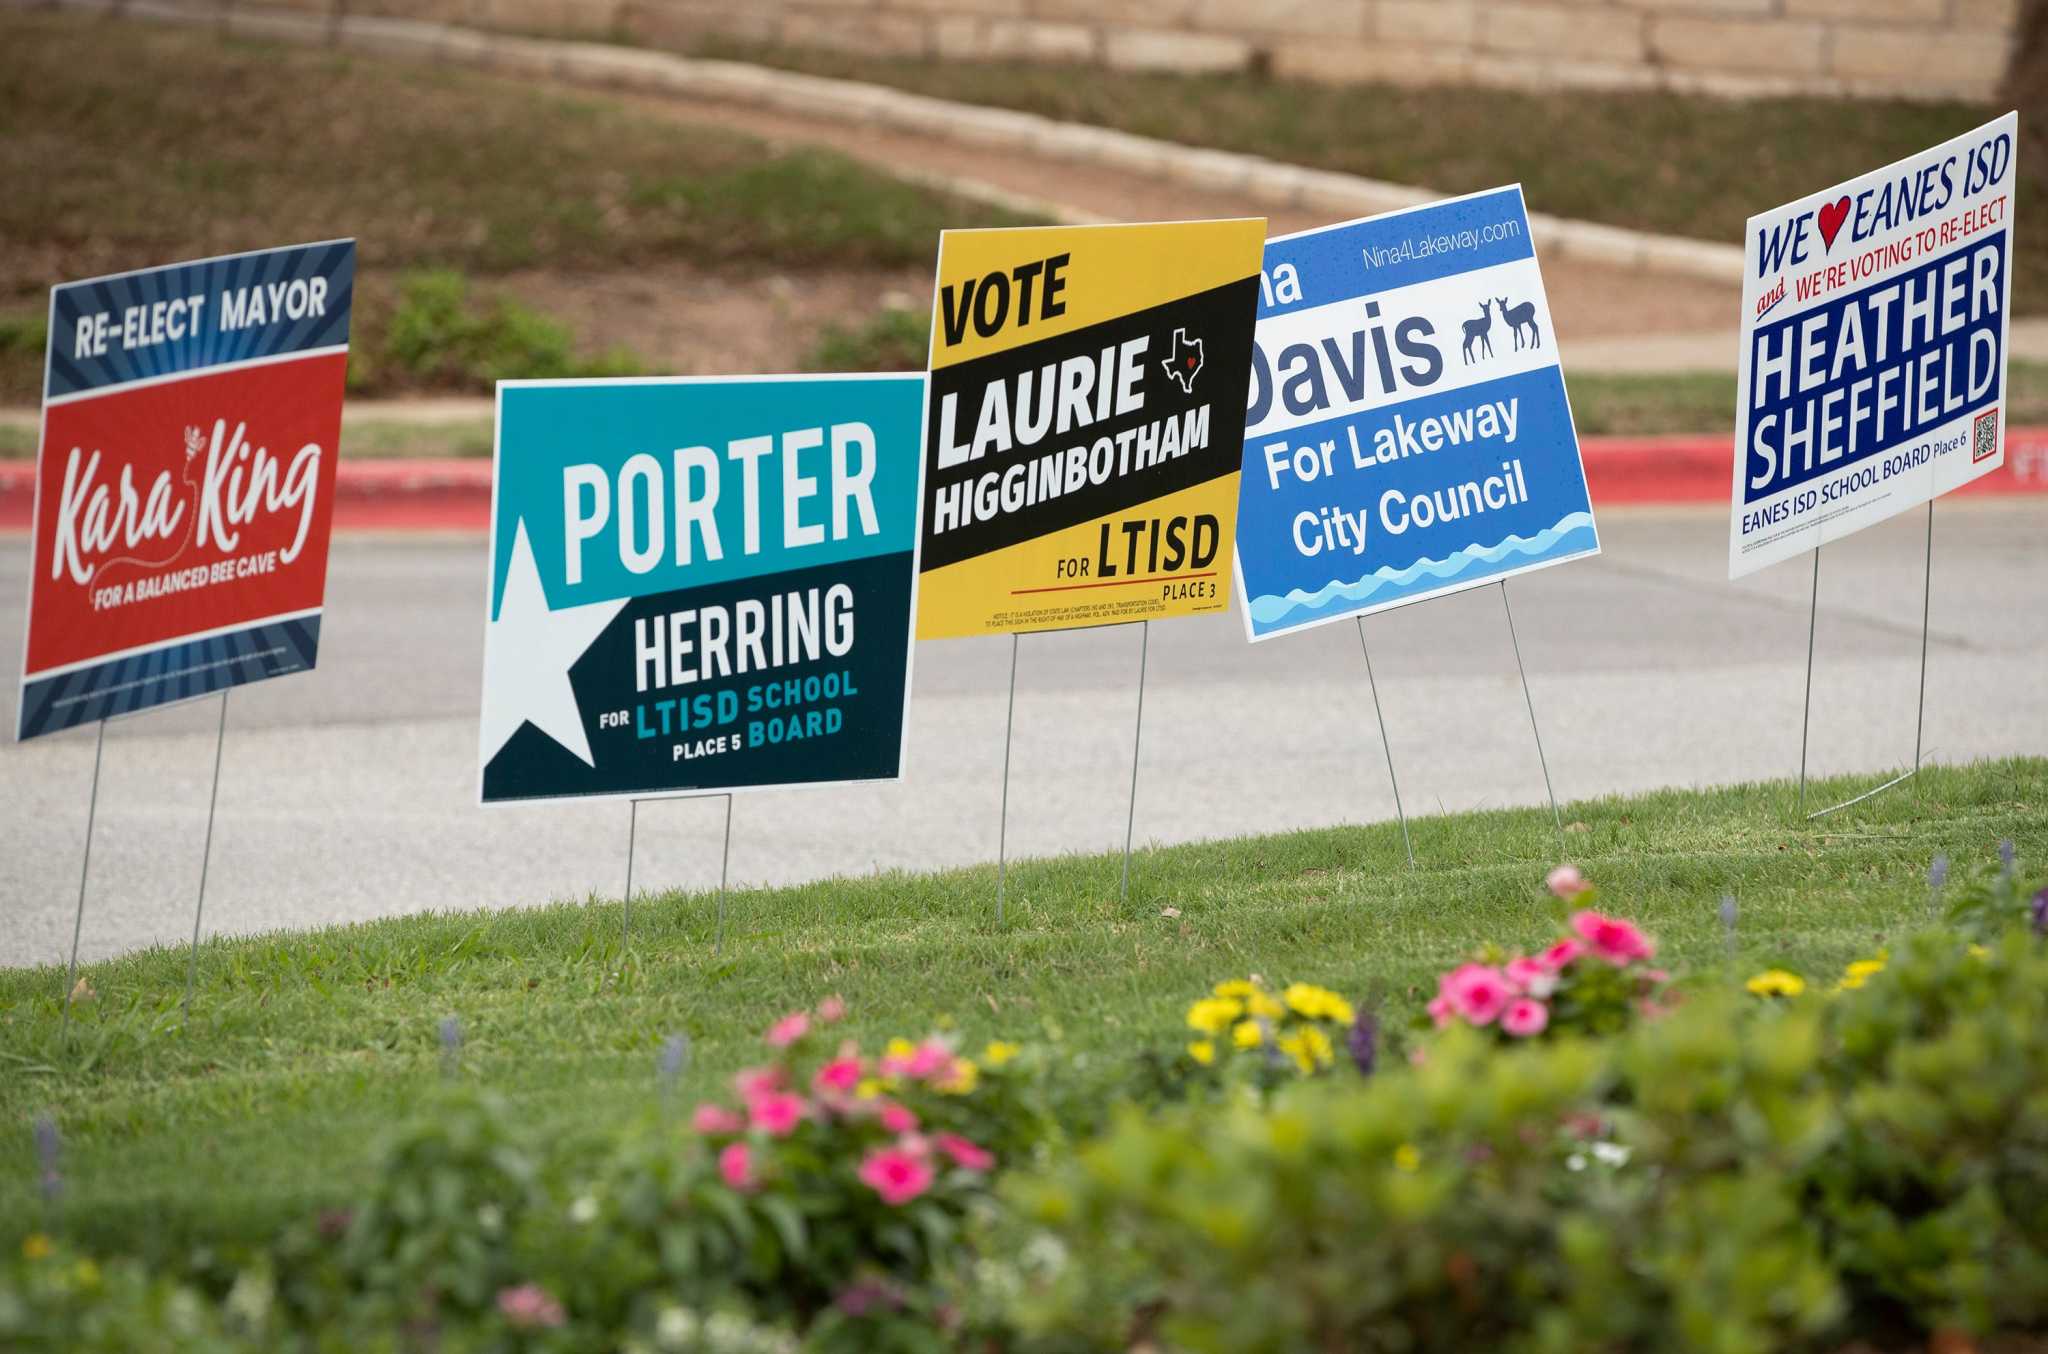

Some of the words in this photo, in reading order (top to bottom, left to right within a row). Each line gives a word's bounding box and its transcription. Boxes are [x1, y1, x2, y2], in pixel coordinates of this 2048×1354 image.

[1363, 217, 1520, 271] Nina4Lakeway.com
[1757, 277, 1786, 315] and
[1796, 262, 1847, 303] WE'RE
[1850, 237, 1912, 281] VOTING
[1916, 228, 1936, 256] TO
[1940, 195, 2007, 247] RE-ELECT
[1759, 211, 1814, 279] WE
[1852, 156, 1957, 242] EANES
[1963, 133, 2011, 199] ISD
[75, 294, 205, 359] RE-ELECT
[220, 277, 329, 332] MAYOR
[941, 253, 1071, 348] VOTE
[1755, 244, 2000, 410] HEATHER
[938, 335, 1150, 470] LAURIE
[1264, 440, 1336, 490] For
[1347, 398, 1519, 470] Lakeway
[1750, 327, 1997, 490] SHEFFIELD
[52, 447, 185, 585] Kara
[196, 418, 322, 566] King
[563, 422, 880, 586] PORTER
[933, 404, 1211, 535] HIGGINBOTHAM
[1292, 505, 1368, 557] City
[1379, 459, 1529, 535] Council
[1742, 500, 1789, 535] EANES
[1793, 490, 1817, 516] ISD
[1821, 466, 1879, 504] SCHOOL
[1882, 444, 1931, 480] BOARD
[1933, 438, 1958, 459] Place
[1960, 431, 1967, 446] 6
[94, 584, 123, 611] FOR
[123, 582, 134, 604] A
[136, 565, 210, 601] BALANCED
[210, 560, 236, 584] BEE
[236, 551, 277, 578] CAVE
[1057, 557, 1089, 578] FOR
[1097, 513, 1220, 578] LTISD
[1163, 581, 1205, 601] PLACE
[1209, 583, 1216, 598] 3
[635, 583, 855, 692] HERRING
[599, 710, 630, 730] FOR
[636, 690, 738, 740] LTISD
[747, 670, 858, 712] SCHOOL
[672, 738, 727, 762] PLACE
[730, 735, 742, 751] 5
[748, 707, 843, 748] BOARD
